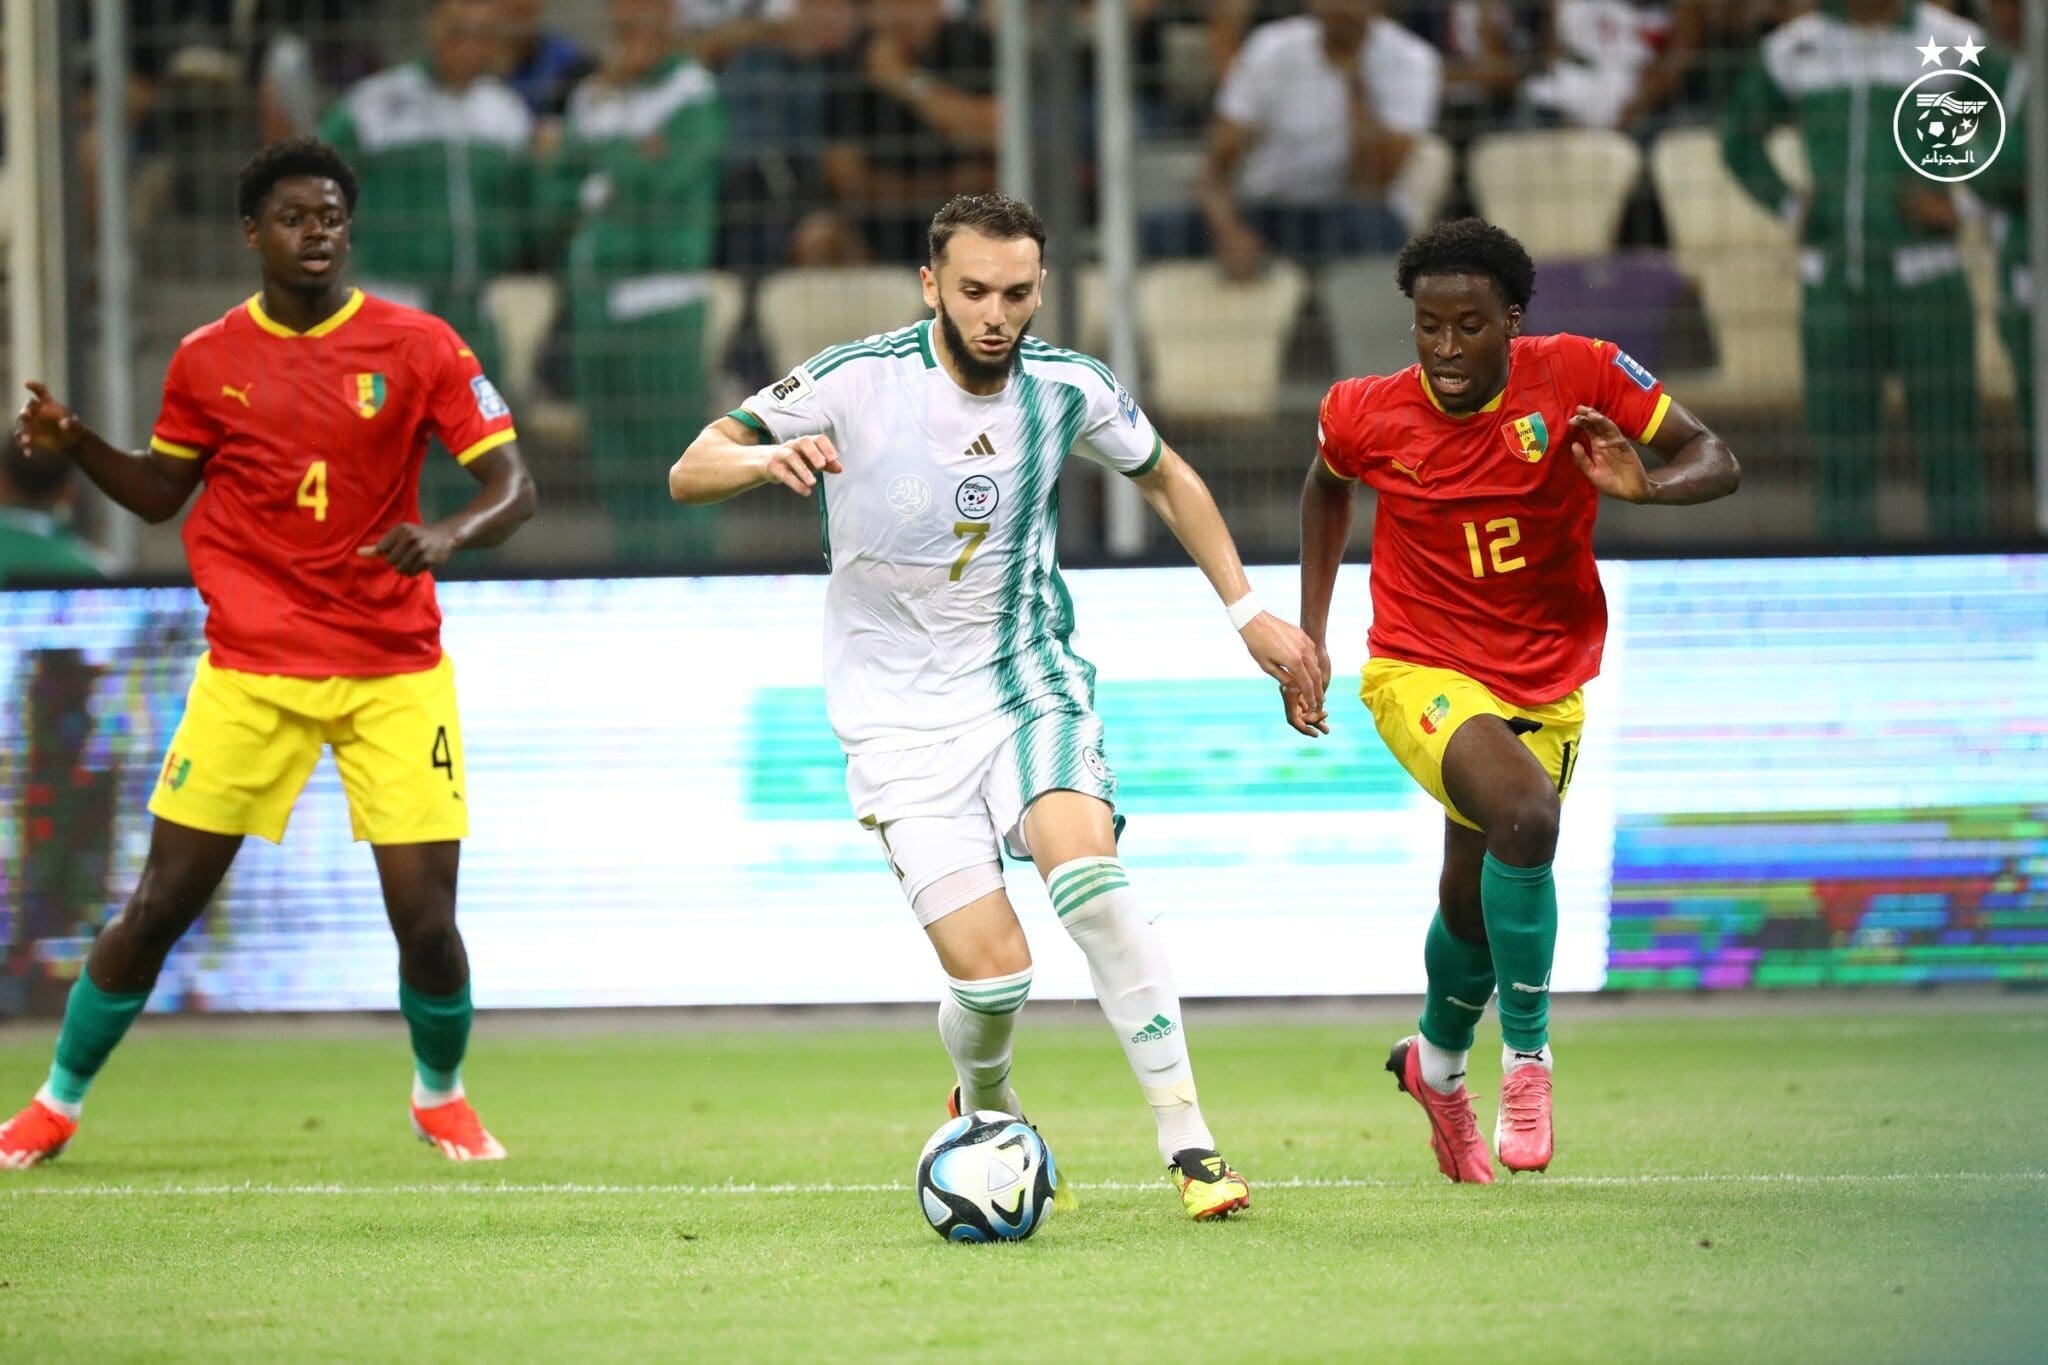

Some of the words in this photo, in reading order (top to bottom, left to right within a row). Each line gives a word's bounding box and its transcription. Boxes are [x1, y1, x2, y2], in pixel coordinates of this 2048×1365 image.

[297, 460, 328, 521] 4
[949, 521, 990, 581] 7
[1462, 517, 1526, 578] 12
[432, 725, 453, 780] 4
[1131, 1022, 1176, 1043] adidas
